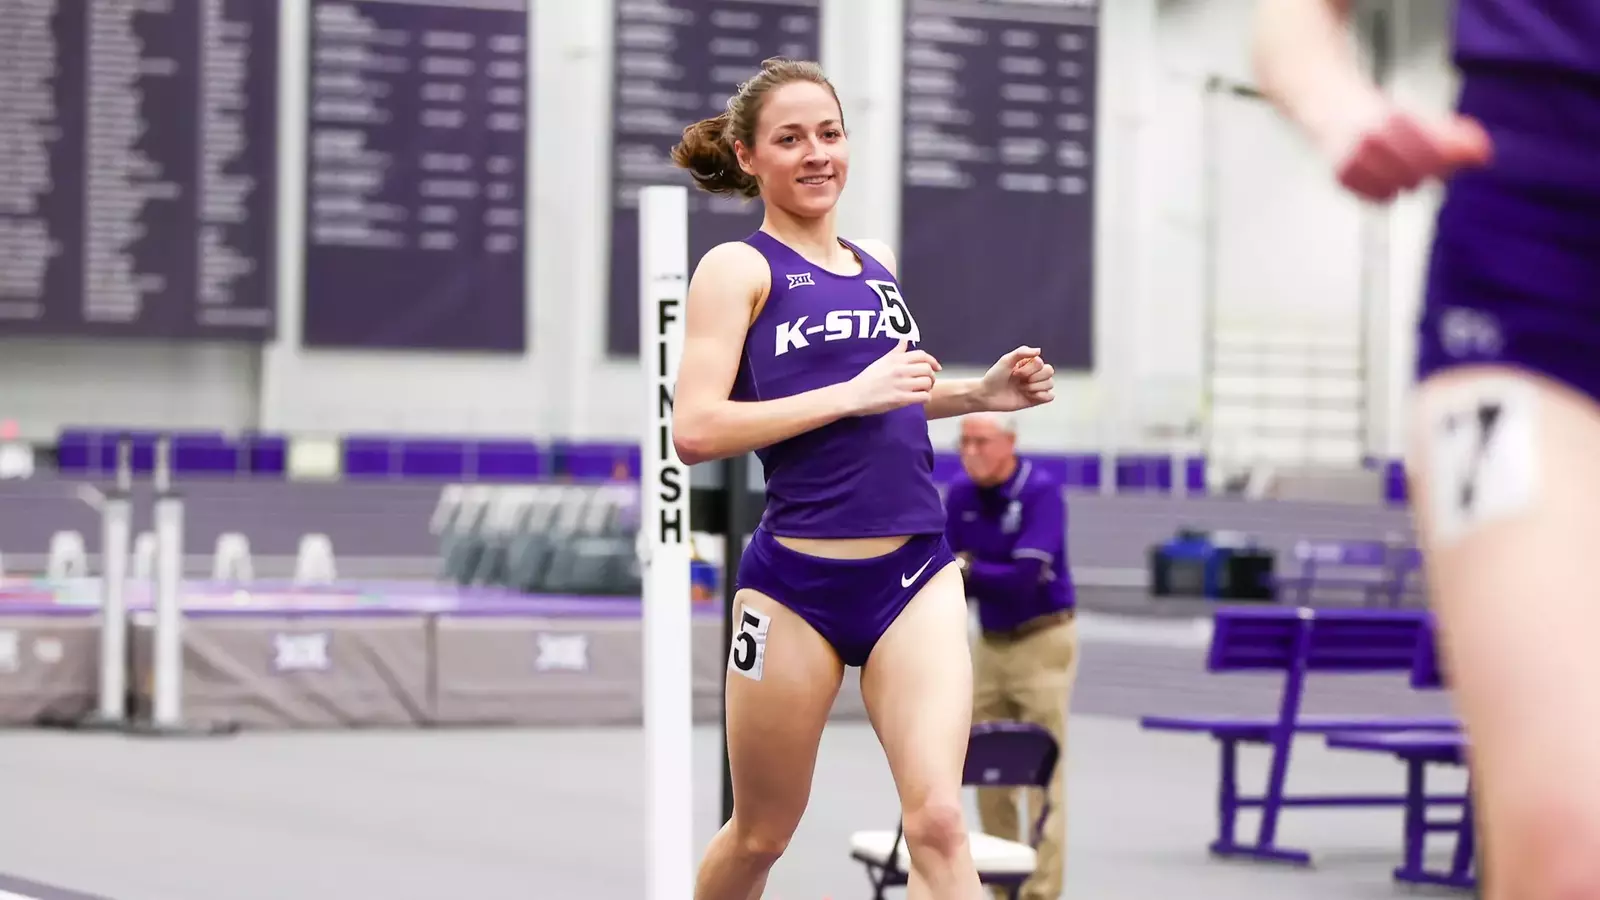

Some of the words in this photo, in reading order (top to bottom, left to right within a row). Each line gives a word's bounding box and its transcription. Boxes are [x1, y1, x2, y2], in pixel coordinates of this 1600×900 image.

[775, 310, 889, 356] K-STA
[877, 284, 911, 334] 5
[659, 299, 681, 543] FINISH
[734, 610, 760, 671] 5
